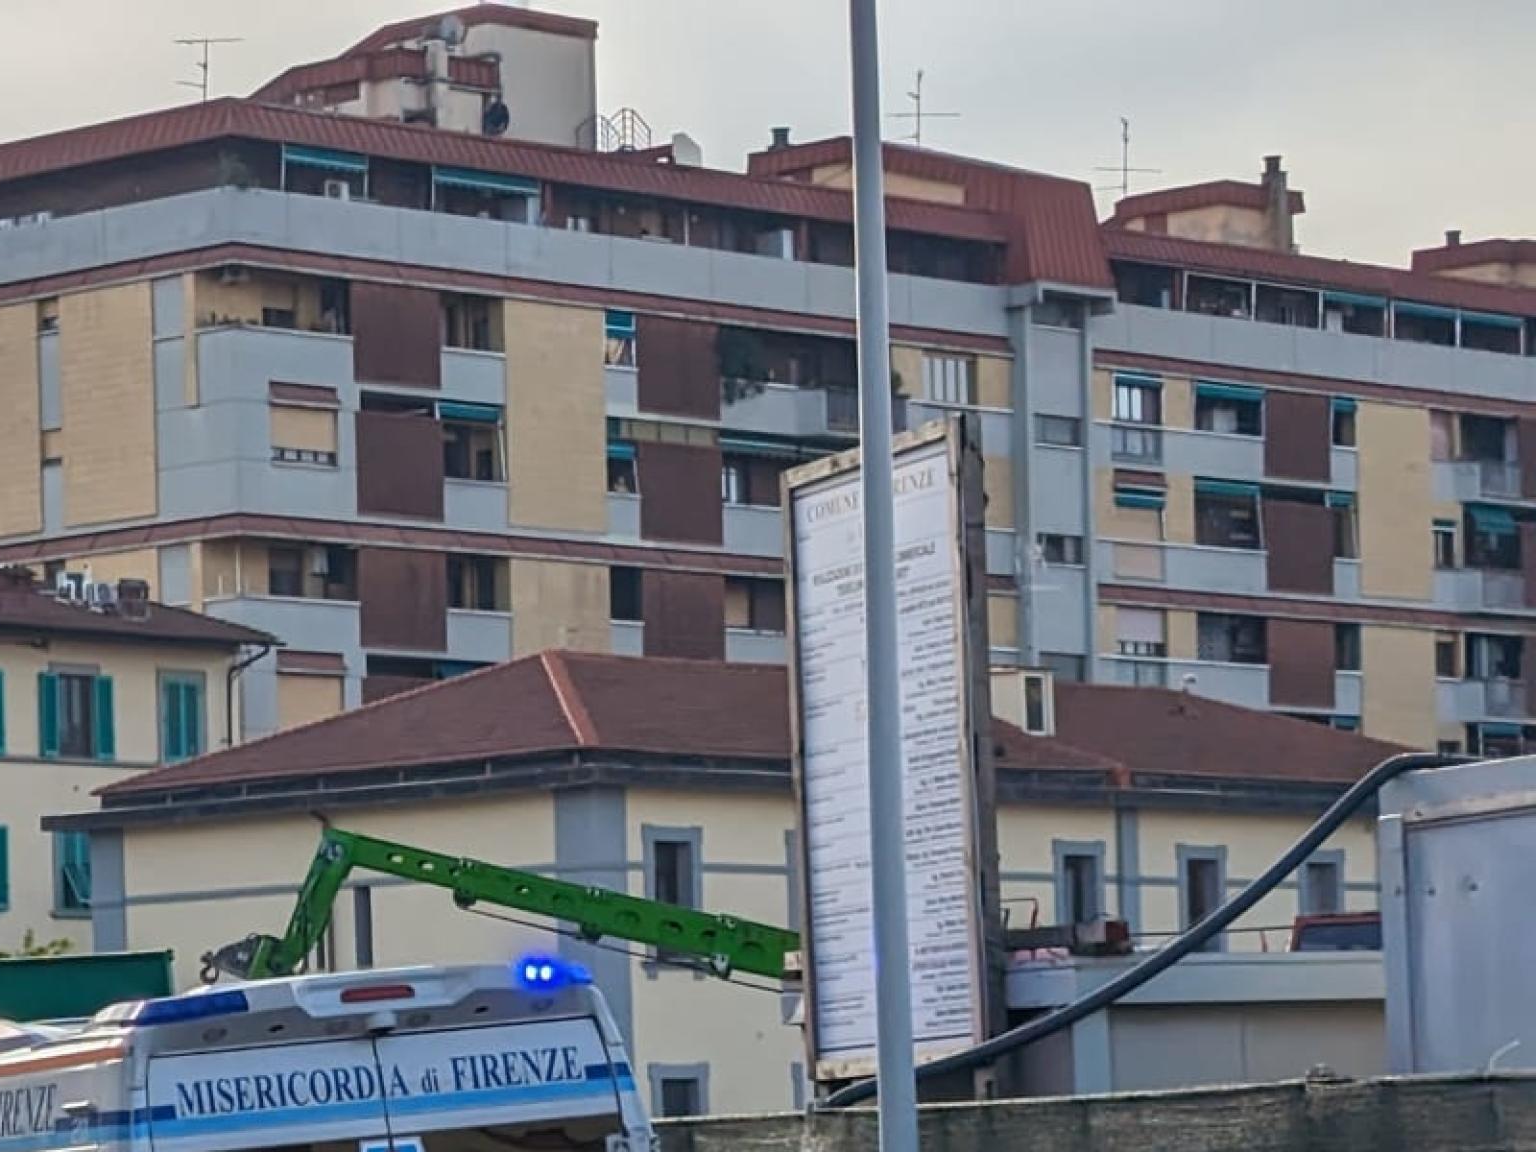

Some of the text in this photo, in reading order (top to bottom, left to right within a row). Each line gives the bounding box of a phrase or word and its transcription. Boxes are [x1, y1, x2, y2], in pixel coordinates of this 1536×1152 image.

[176, 1046, 583, 1117] MISERICORDIA di FIRENZE
